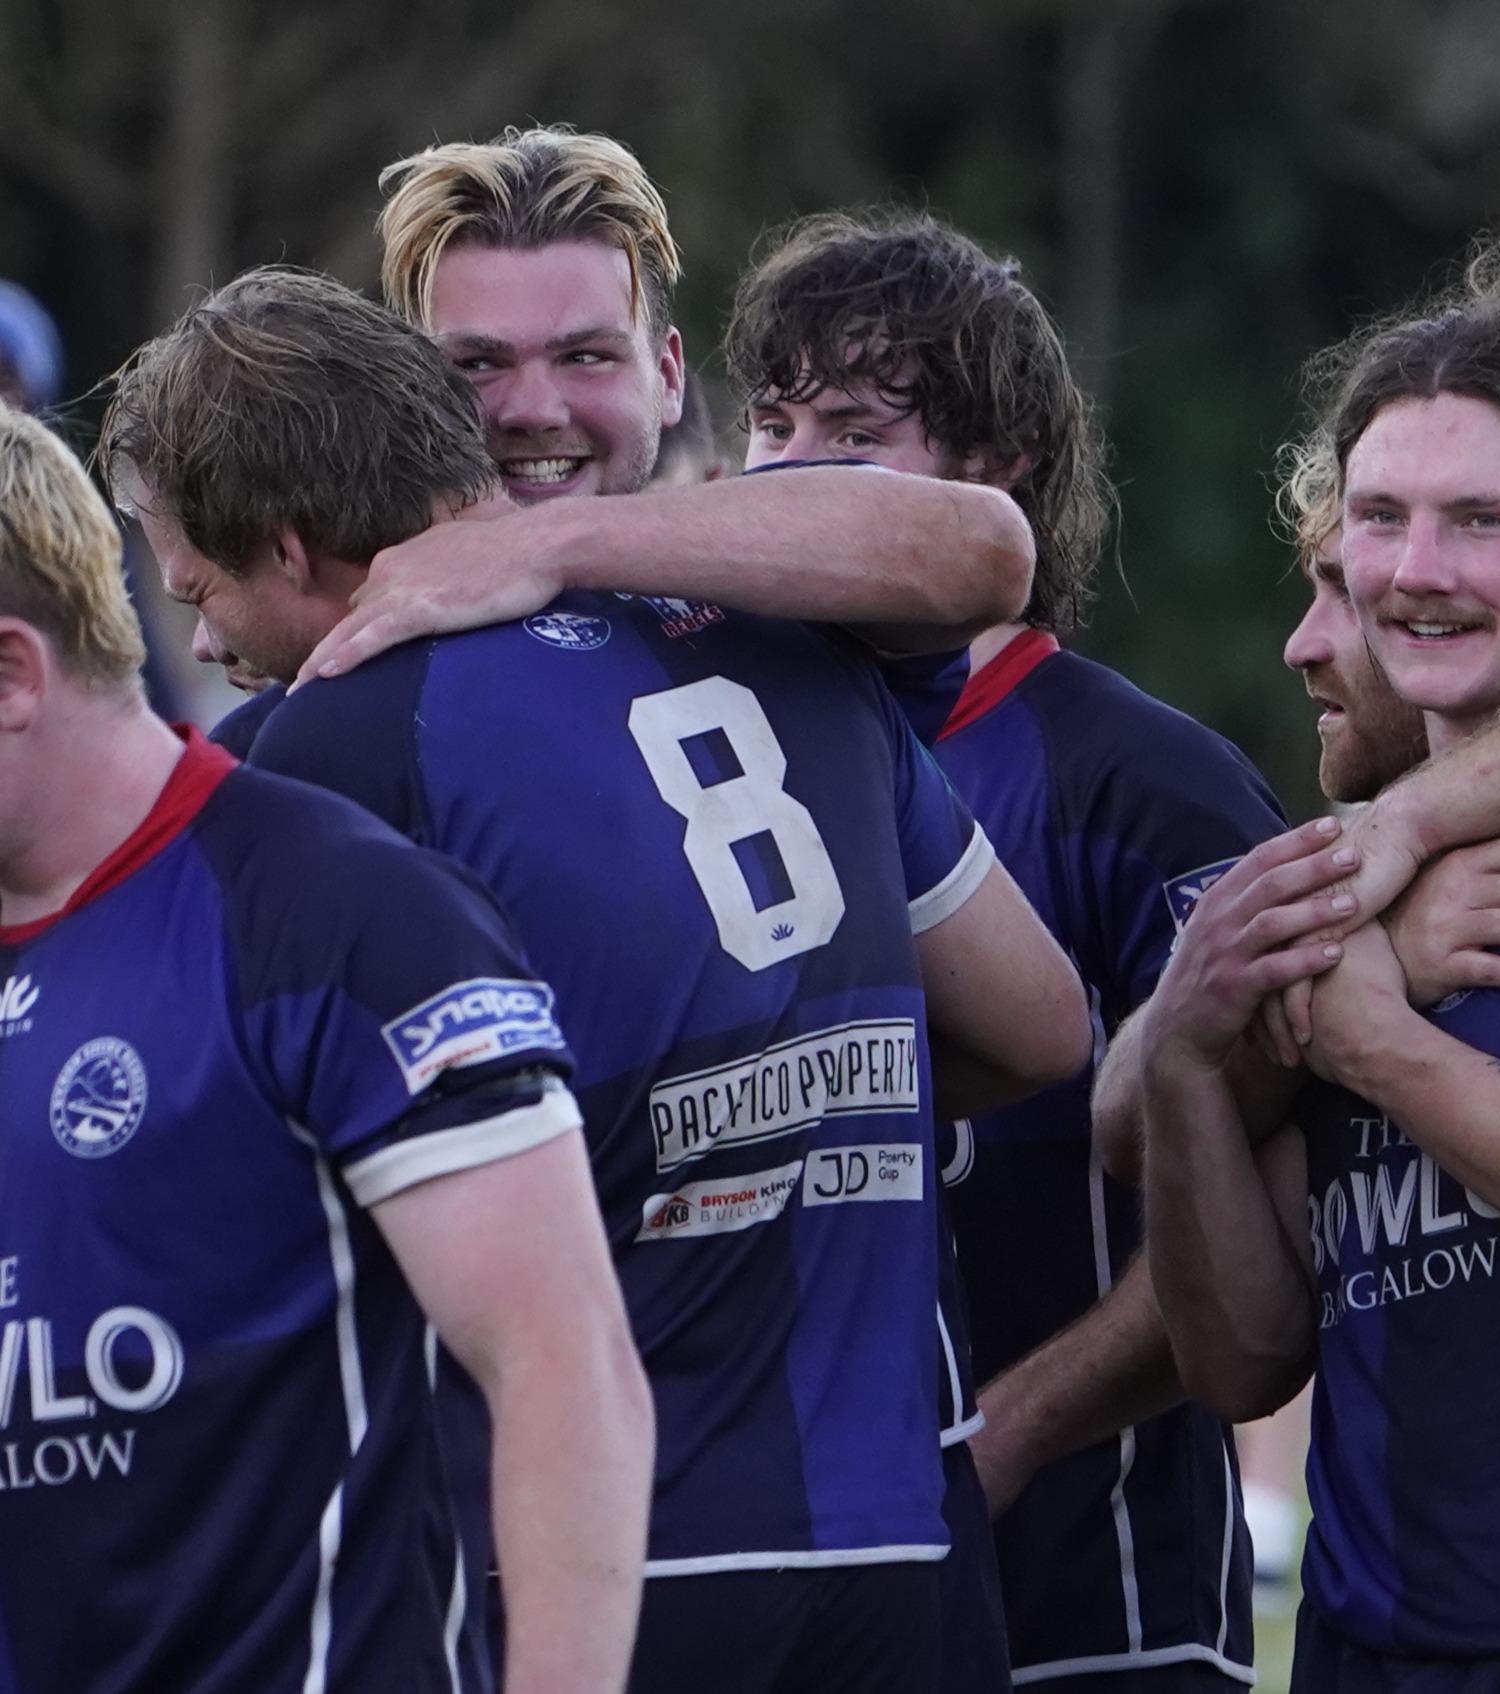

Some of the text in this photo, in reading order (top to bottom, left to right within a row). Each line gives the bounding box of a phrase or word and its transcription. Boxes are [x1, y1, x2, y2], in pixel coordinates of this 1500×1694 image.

[662, 605, 725, 637] REBELS
[628, 675, 845, 971] 8
[651, 1061, 791, 1156] PACIFICO
[813, 1151, 870, 1198] JD
[700, 1195, 785, 1222] BUILDIN
[701, 1189, 757, 1208] BRYSON
[0, 1428, 137, 1490] LOW
